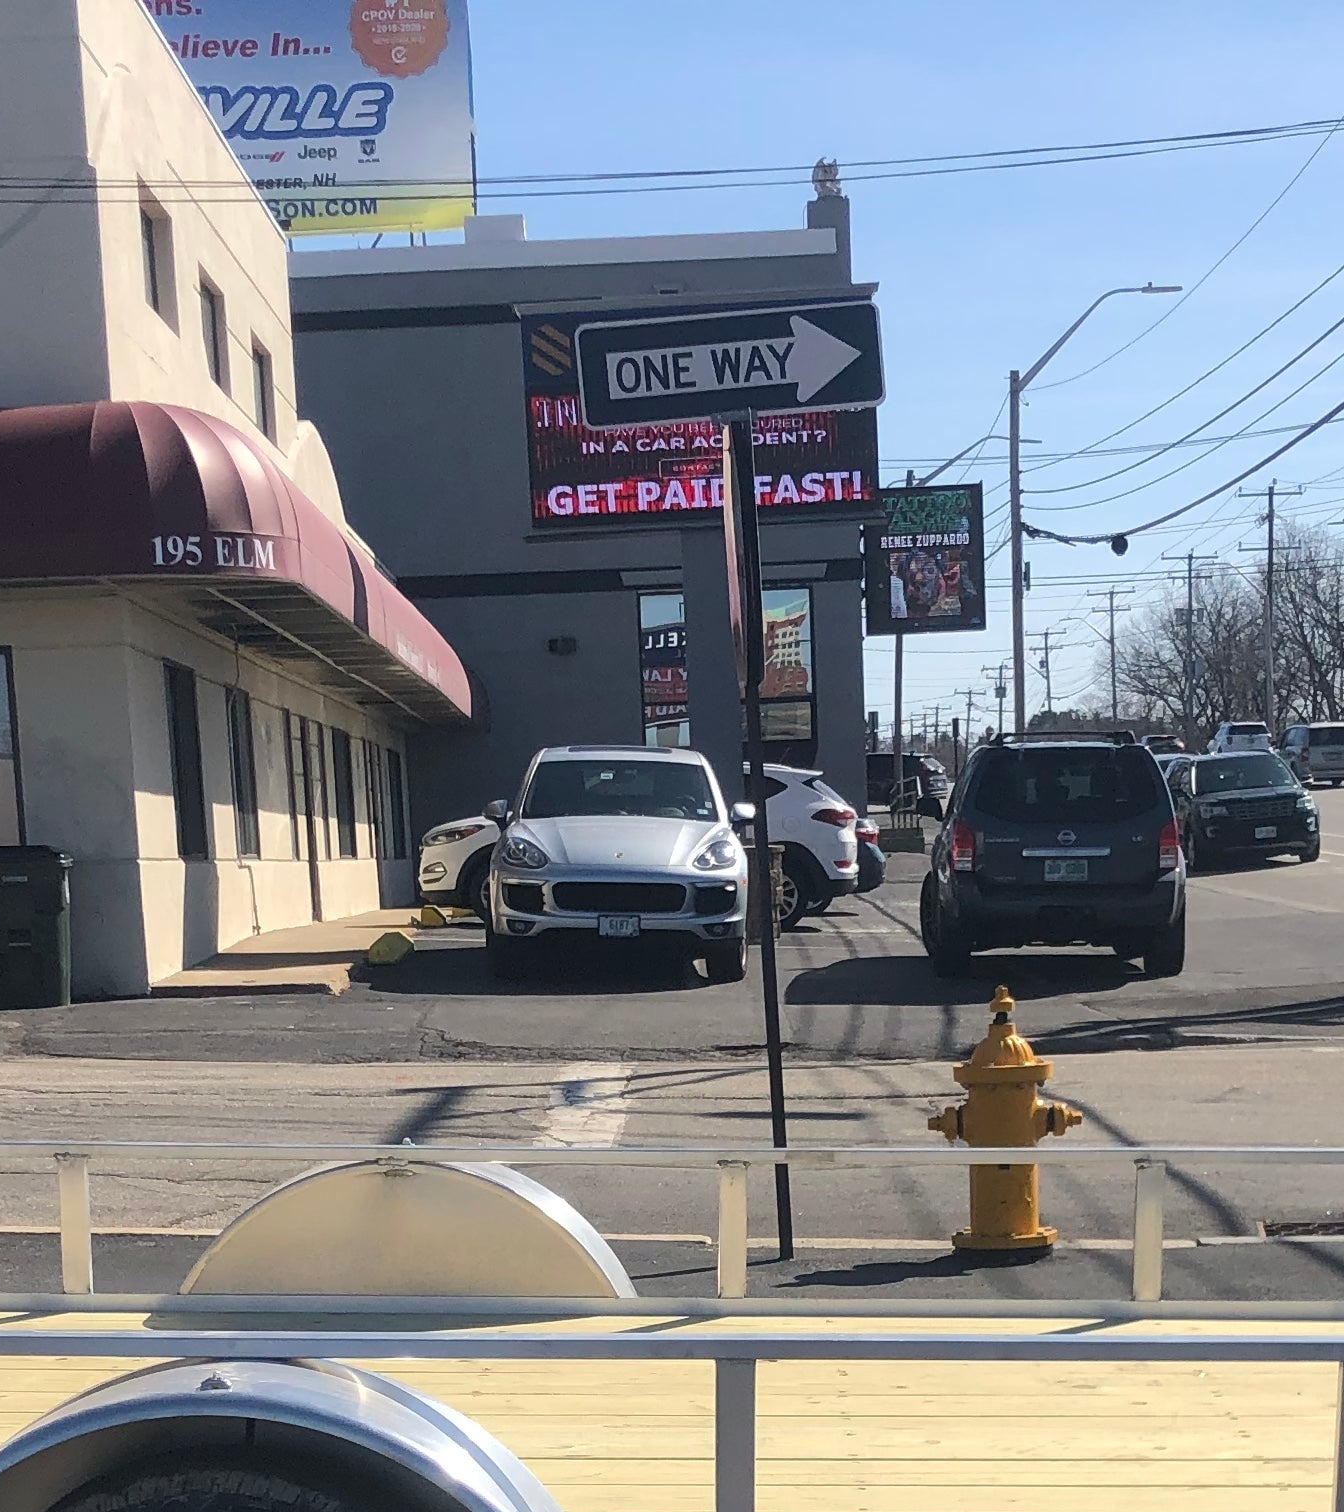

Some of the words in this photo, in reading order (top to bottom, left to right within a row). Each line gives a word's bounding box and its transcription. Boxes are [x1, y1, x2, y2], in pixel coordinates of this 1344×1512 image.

[361, 9, 395, 21] CPOV
[398, 9, 435, 19] Dealer
[170, 34, 258, 58] lieve
[200, 84, 392, 138] VILLE
[297, 145, 337, 161] Jeep
[254, 177, 306, 190] ESTER,
[313, 173, 337, 187] NH
[267, 199, 377, 219] SON.COM
[616, 352, 696, 393] ONE
[710, 342, 794, 385] WAY
[582, 440, 605, 454] IN
[612, 440, 629, 453] A
[636, 436, 685, 452] CAR
[692, 430, 827, 449] ACDENT?
[547, 482, 622, 515] GET
[754, 471, 861, 505] FAST!
[152, 535, 203, 566] 195
[214, 536, 276, 570] ELM
